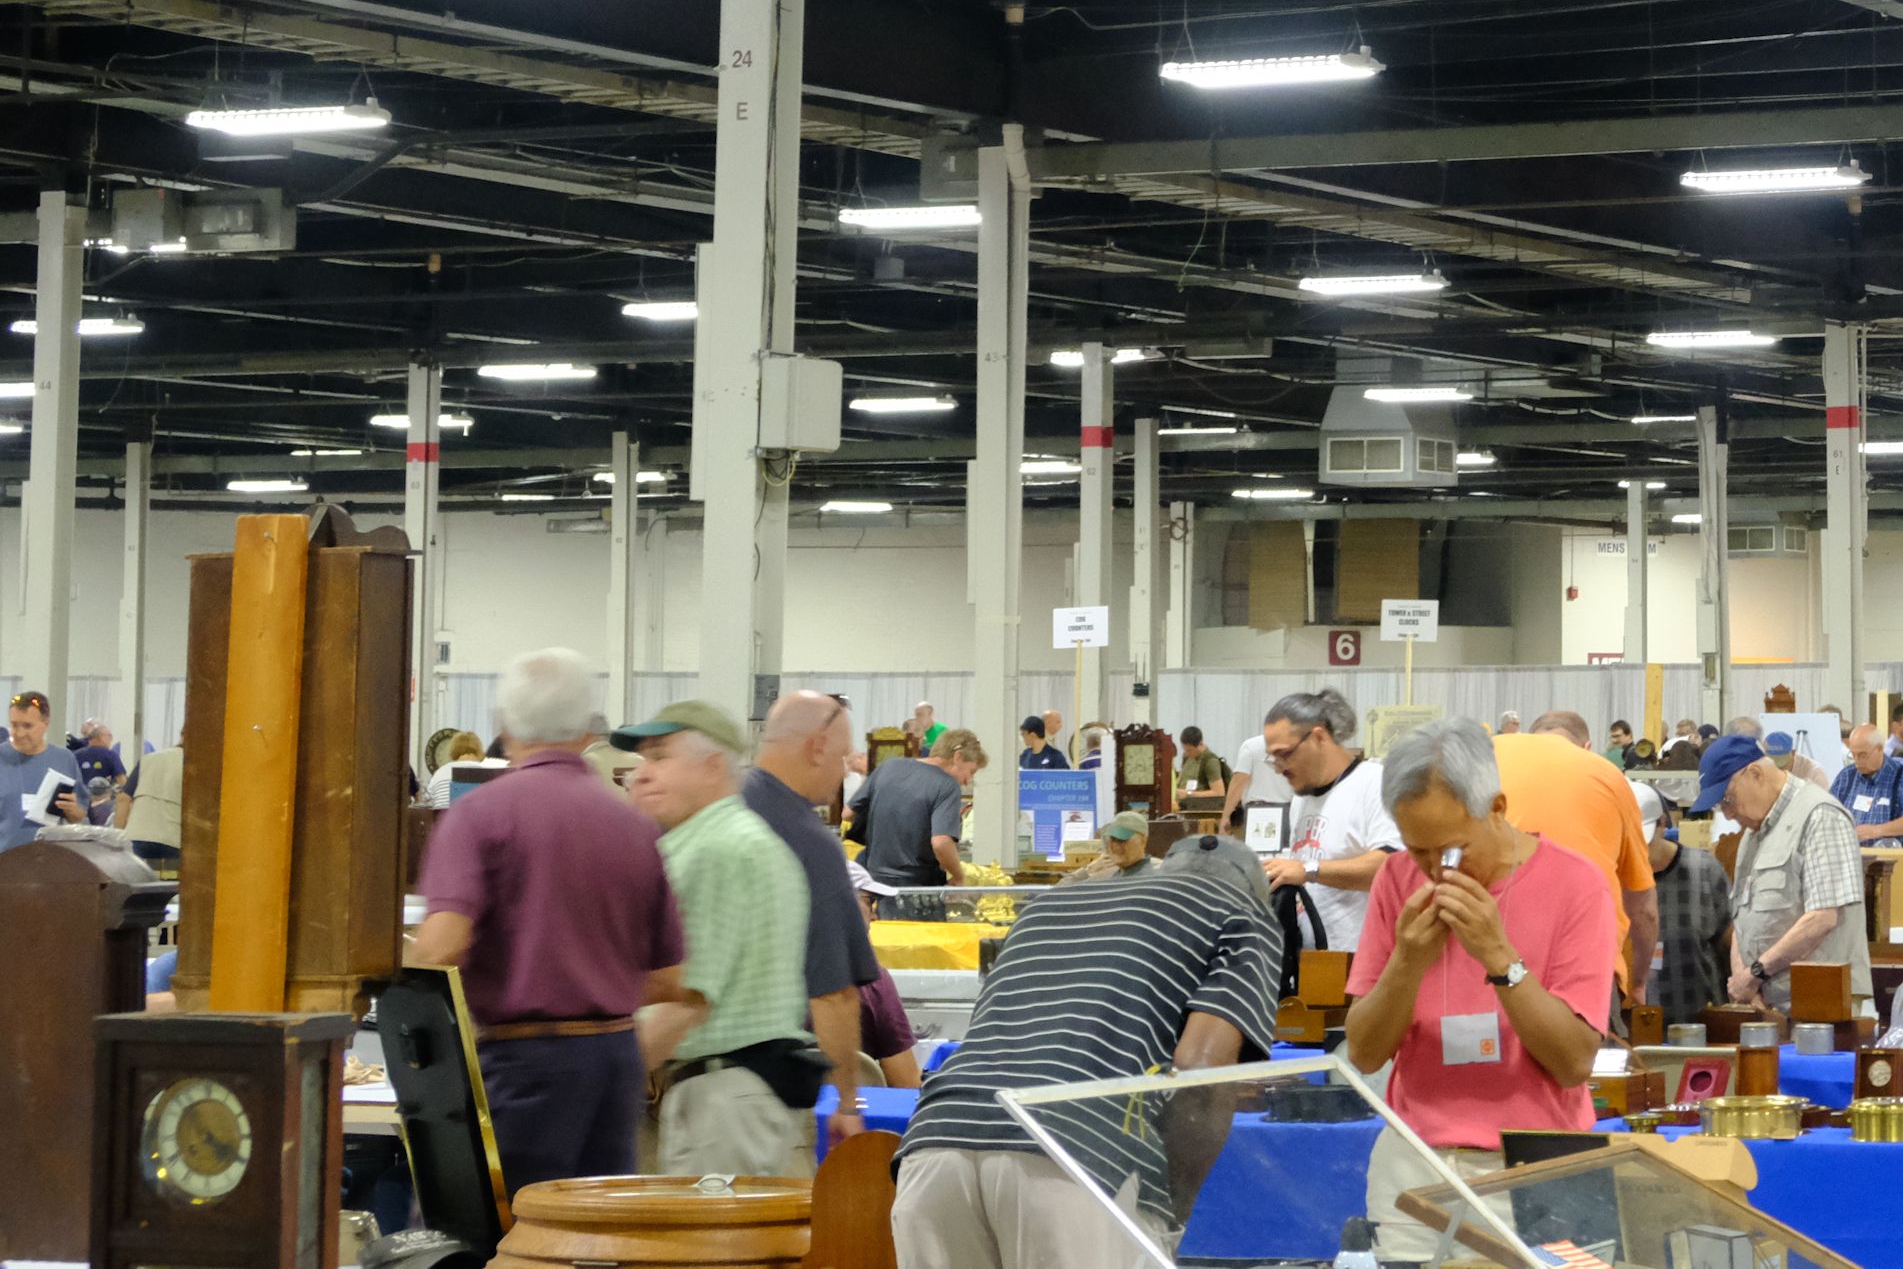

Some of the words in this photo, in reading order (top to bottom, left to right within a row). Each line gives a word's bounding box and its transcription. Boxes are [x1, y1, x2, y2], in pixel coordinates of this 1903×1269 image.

[732, 50, 753, 69] 24
[736, 102, 749, 121] E
[985, 351, 999, 363] 43
[40, 381, 51, 390] 44
[1833, 449, 1843, 458] 61
[1087, 466, 1097, 475] 62
[1597, 542, 1626, 554] MENS
[1335, 633, 1357, 661] 6
[1039, 780, 1090, 791] COUNTERS
